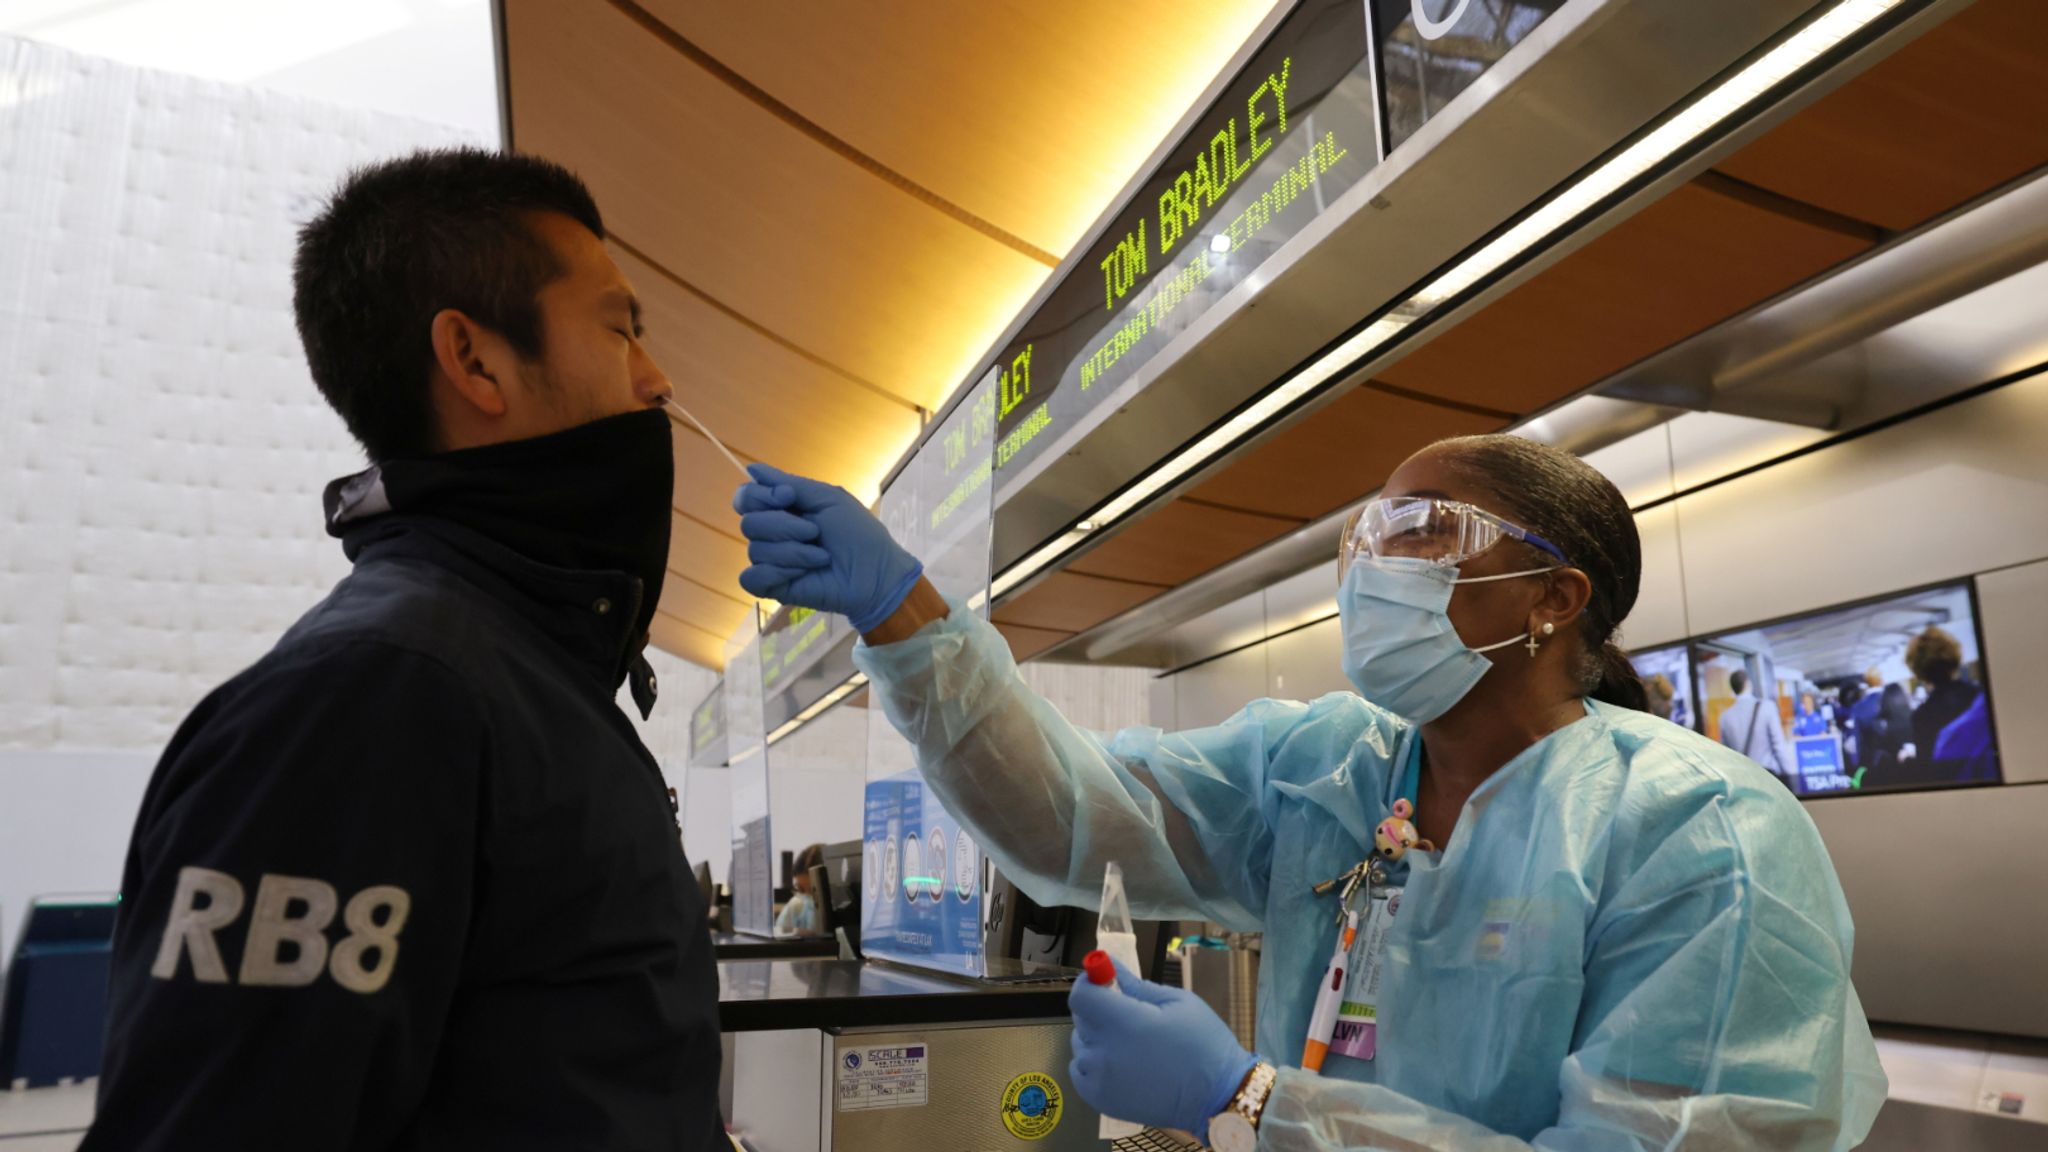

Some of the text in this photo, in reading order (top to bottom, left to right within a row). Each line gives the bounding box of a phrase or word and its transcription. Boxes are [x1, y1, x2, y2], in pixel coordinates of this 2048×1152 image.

[1101, 57, 1290, 310] TOM BRADLEY
[1080, 248, 1216, 391] INTERNATIONAL
[151, 865, 411, 994] RB8
[868, 1049, 905, 1061] SCALE
[1333, 1019, 1363, 1043] LVN
